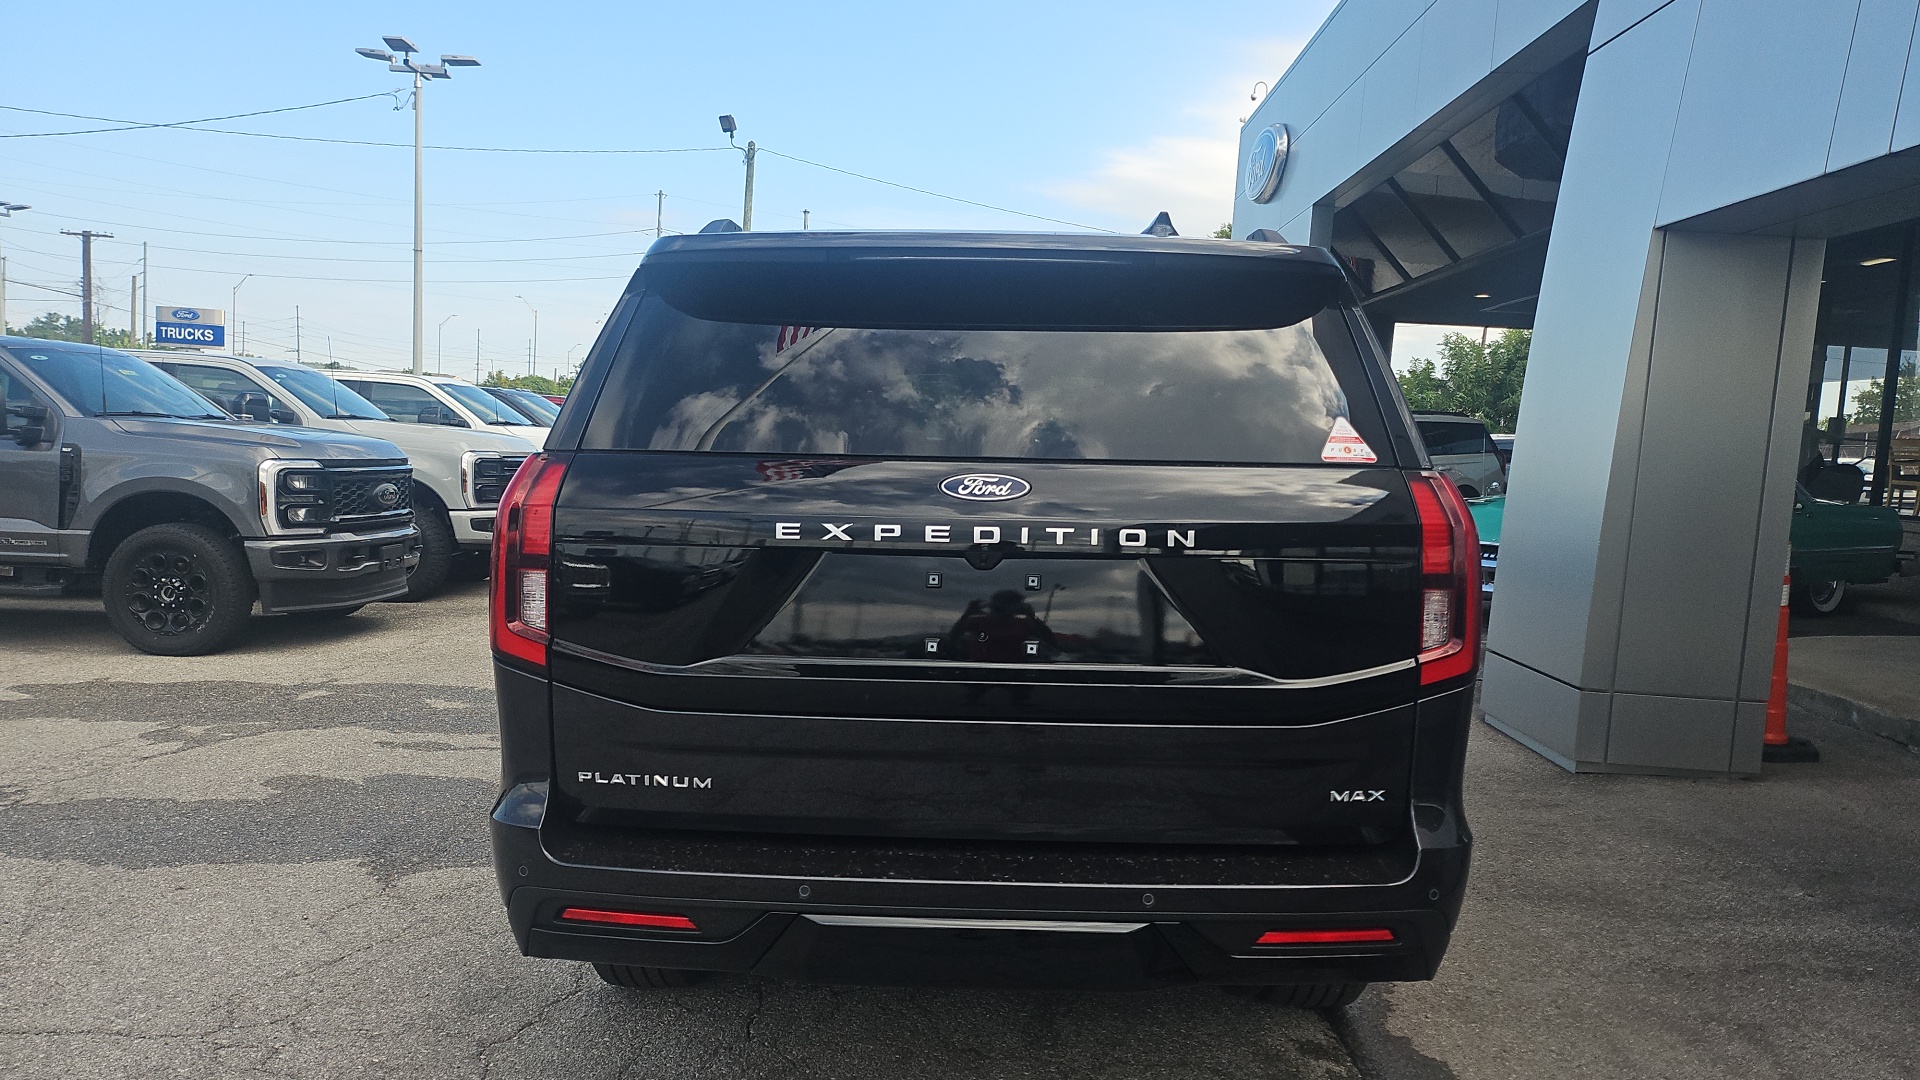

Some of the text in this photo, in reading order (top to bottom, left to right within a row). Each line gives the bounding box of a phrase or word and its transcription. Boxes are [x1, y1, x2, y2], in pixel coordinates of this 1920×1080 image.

[176, 310, 194, 319] Ford
[160, 326, 214, 342] TRUCKS
[957, 477, 1013, 496] Ford
[775, 522, 1196, 548] EXPEDITION
[578, 771, 712, 789] PLATINUM
[1330, 790, 1386, 802] MAX
